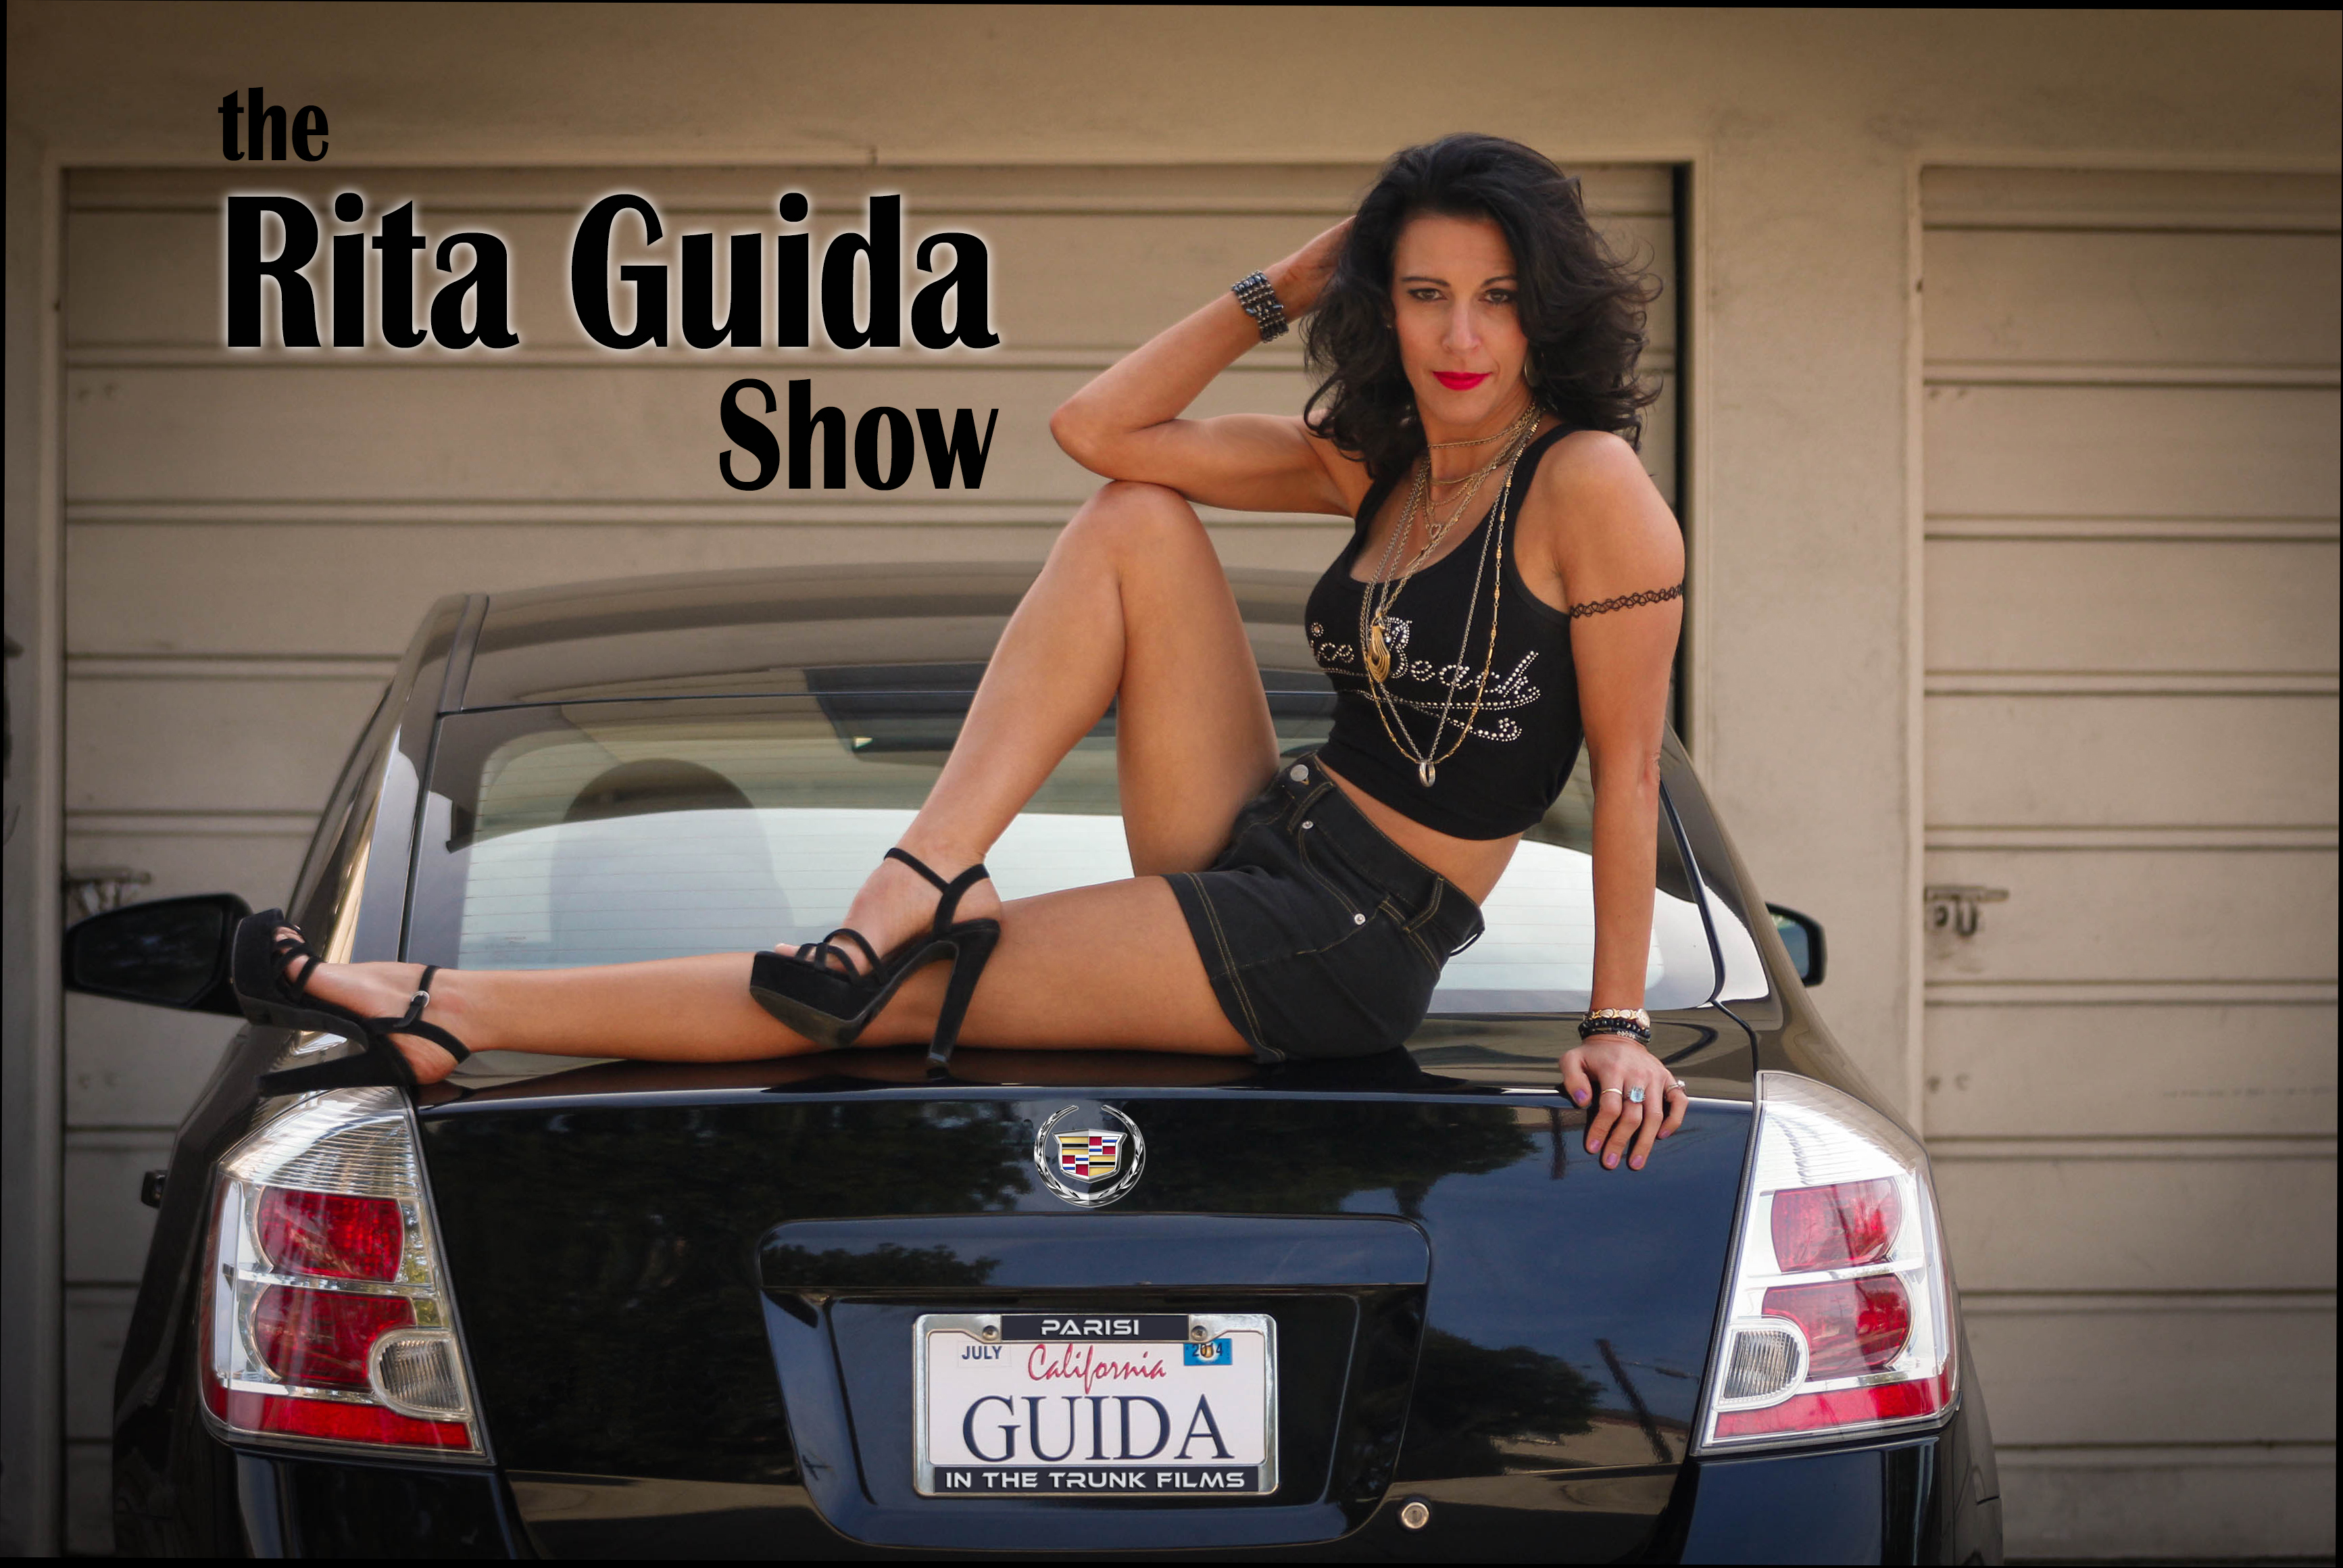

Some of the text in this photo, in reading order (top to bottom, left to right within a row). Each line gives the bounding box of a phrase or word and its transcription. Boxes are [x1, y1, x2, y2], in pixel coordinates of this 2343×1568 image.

[1041, 1319, 1139, 1336] PARISI
[961, 1346, 1002, 1360] JULY
[1028, 1343, 1166, 1394] California
[962, 1394, 1235, 1462] GUIDA
[945, 1472, 1245, 1488] IN THE TRUNK FILMS
